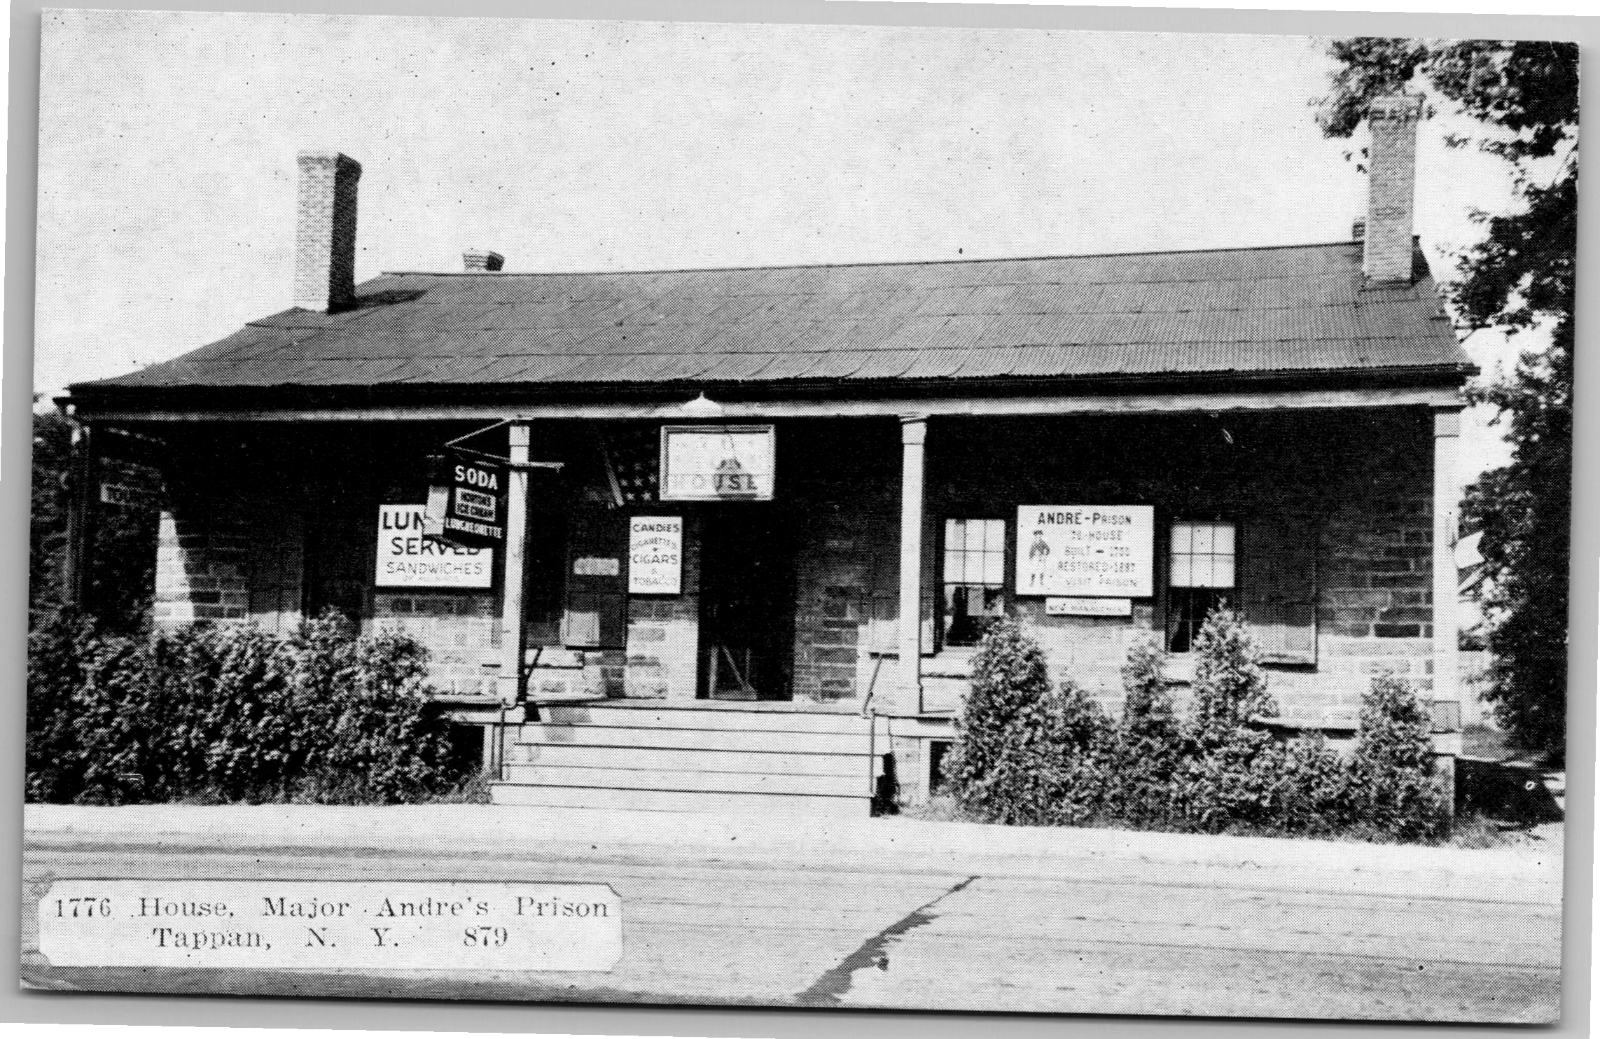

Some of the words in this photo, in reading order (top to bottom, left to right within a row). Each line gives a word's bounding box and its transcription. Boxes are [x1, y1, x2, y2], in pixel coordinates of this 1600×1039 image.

[454, 464, 498, 490] SODA
[382, 511, 425, 531] LUN
[632, 523, 680, 533] CANDIES
[632, 554, 678, 565] CIGARS
[386, 561, 483, 576] SANDWICHES
[633, 577, 678, 587] TOBACCO
